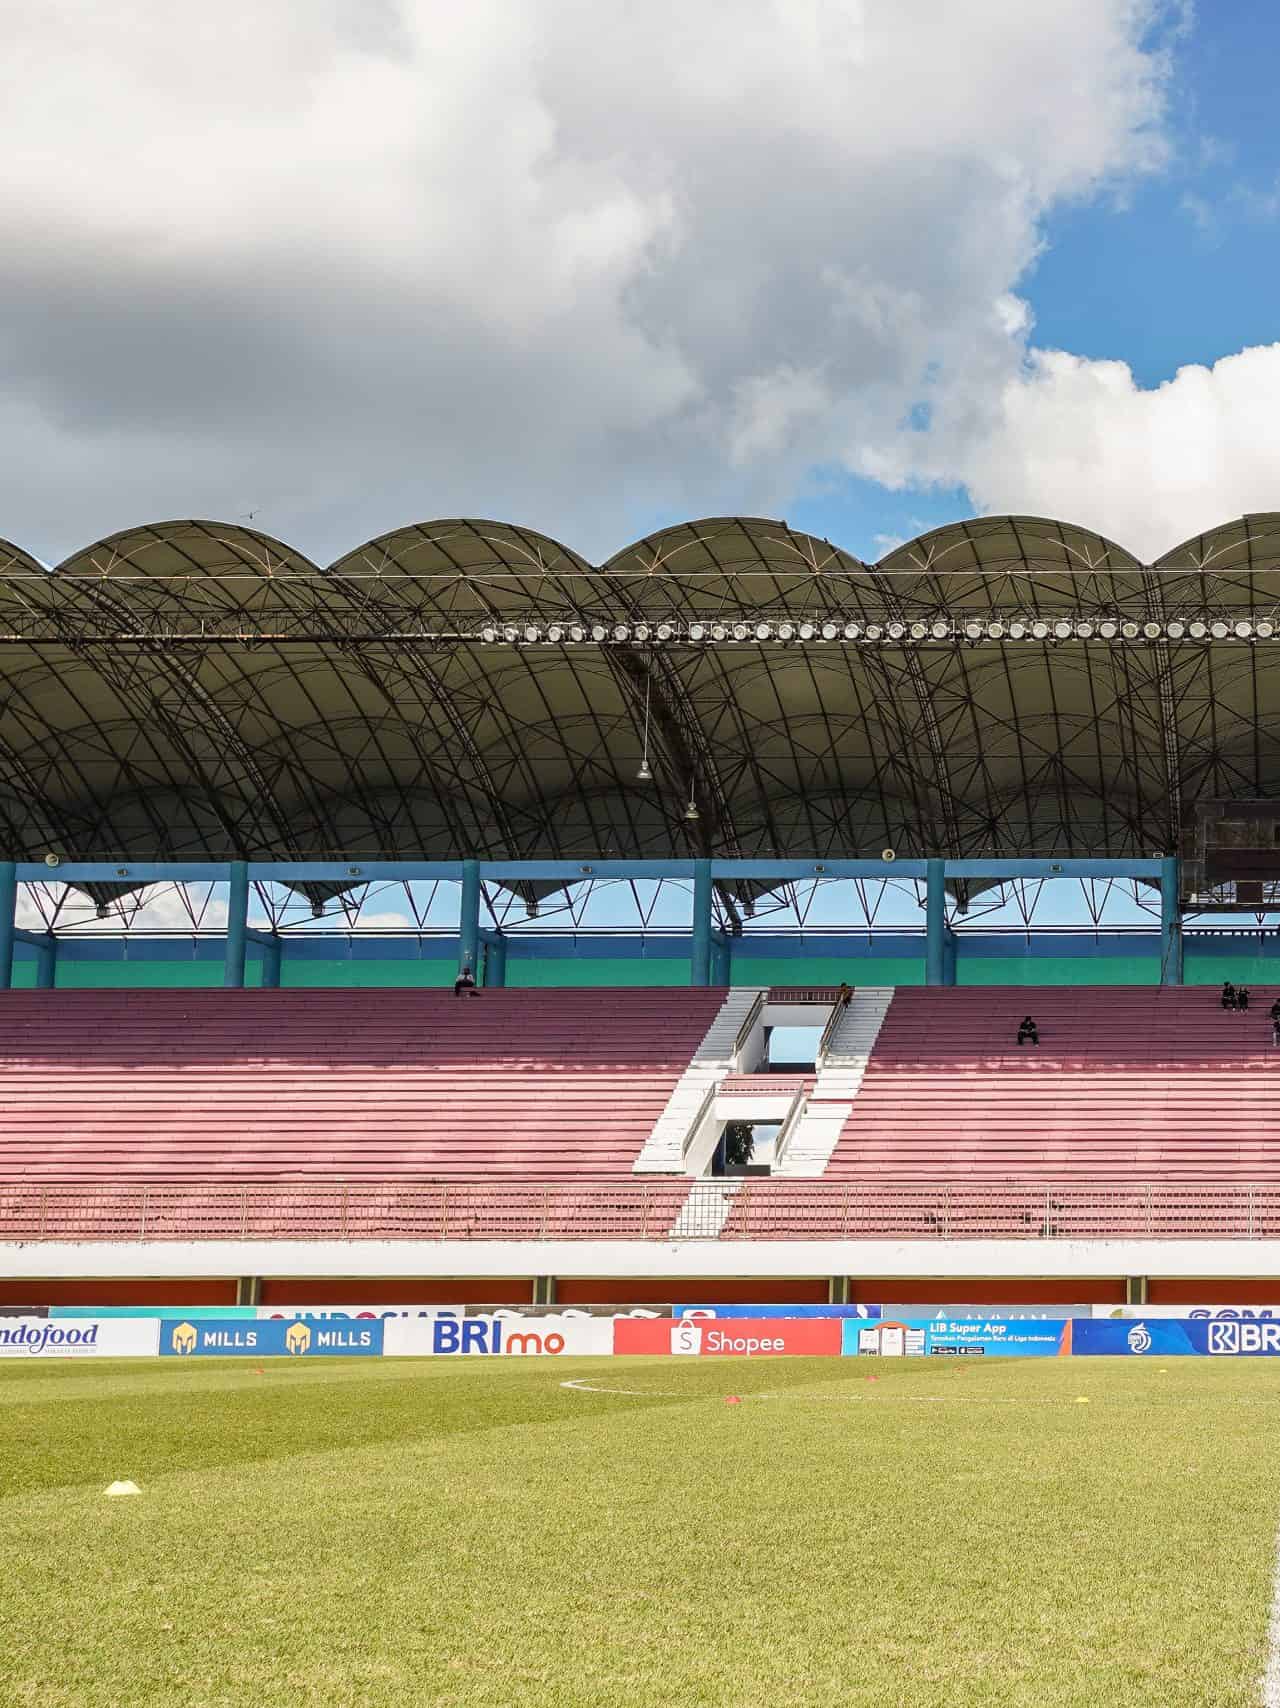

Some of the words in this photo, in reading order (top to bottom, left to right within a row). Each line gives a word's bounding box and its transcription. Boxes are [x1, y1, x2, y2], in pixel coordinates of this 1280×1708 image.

[950, 1322, 981, 1335] Super
[984, 1323, 1007, 1336] App
[204, 1331, 257, 1346] MILLS
[317, 1331, 371, 1346] MILLS
[707, 1331, 785, 1355] Shopee
